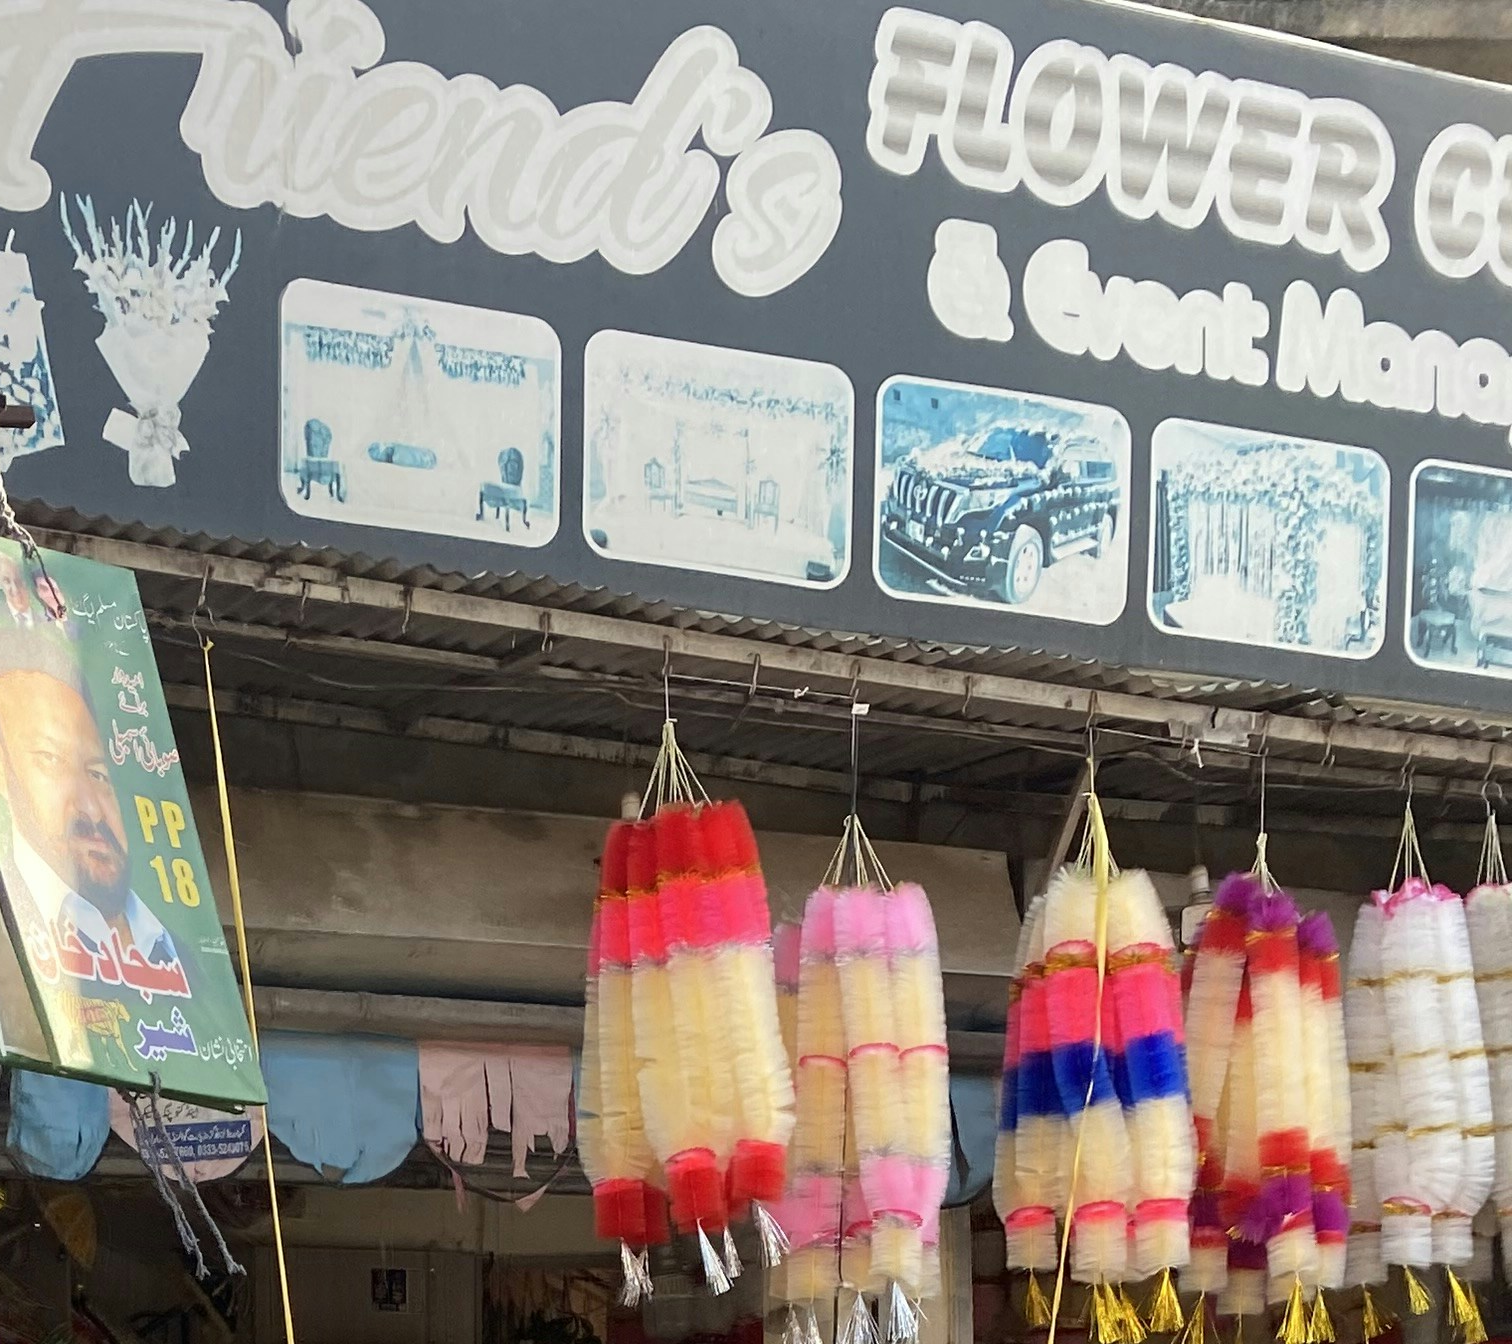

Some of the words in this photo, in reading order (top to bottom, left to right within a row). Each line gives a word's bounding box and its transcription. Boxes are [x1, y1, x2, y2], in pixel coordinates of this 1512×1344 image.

[866, 6, 1395, 272] FLOWER
[927, 218, 1014, 342] &
[1023, 239, 1270, 386] Event
[134, 795, 186, 849] PP
[150, 856, 201, 908] 18
[28, 916, 99, 985] خان
[96, 926, 192, 1005] سجاد
[134, 1005, 199, 1061] شیر
